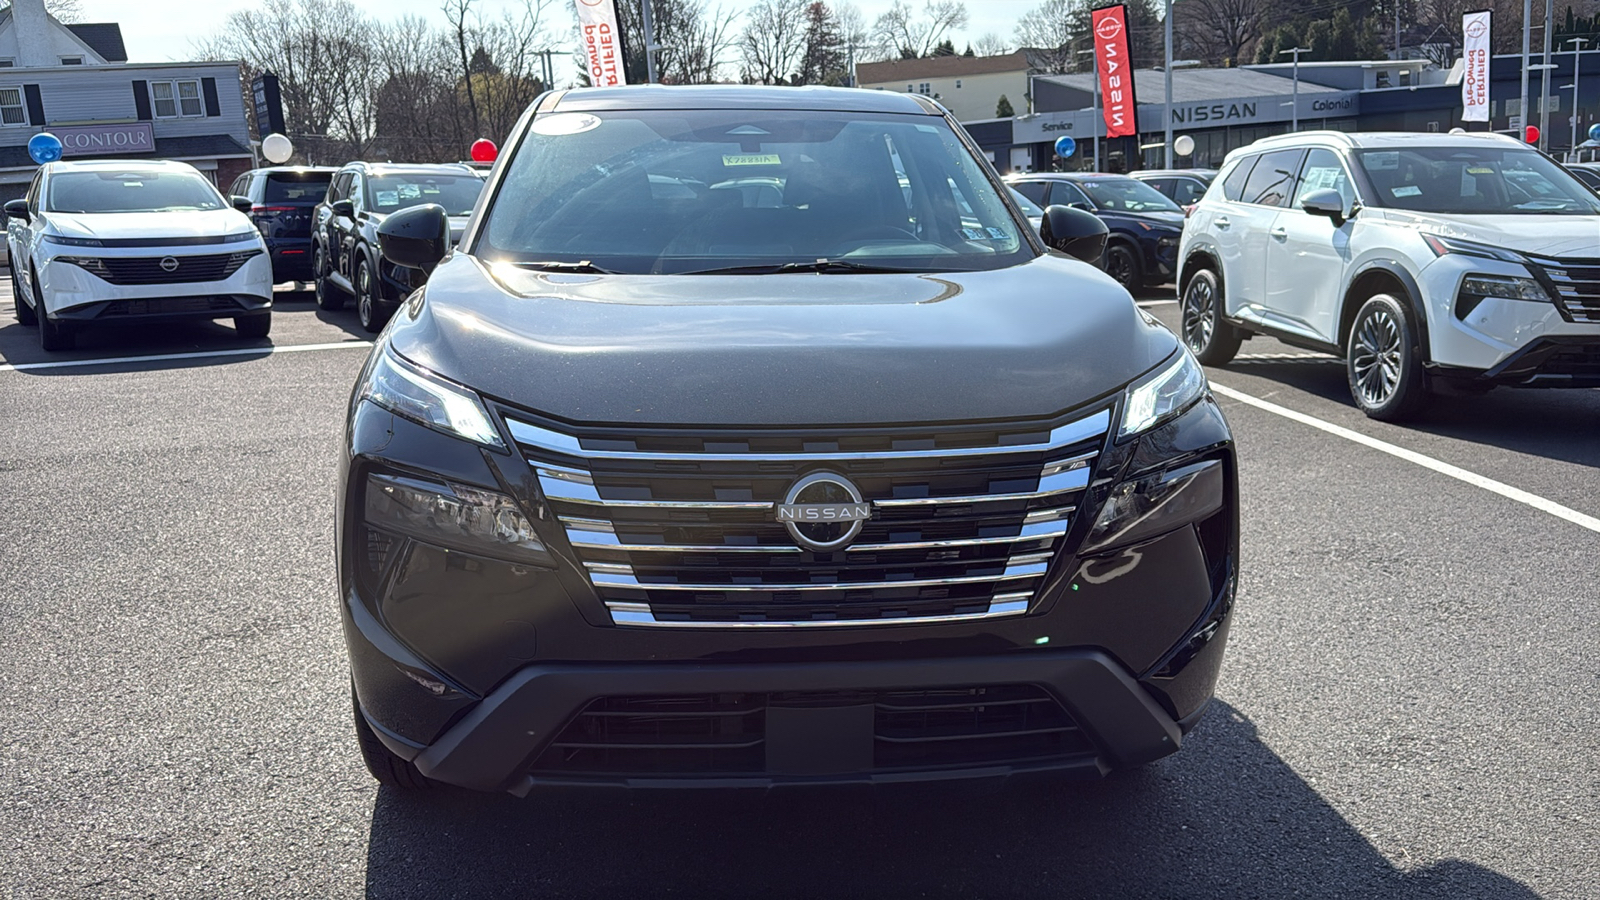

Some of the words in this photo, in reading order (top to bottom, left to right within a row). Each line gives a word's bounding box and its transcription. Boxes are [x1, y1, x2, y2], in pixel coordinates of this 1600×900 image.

[1312, 99, 1352, 112] Colonial
[1172, 102, 1256, 123] NISSAN
[1042, 121, 1073, 132] Service
[63, 132, 147, 148] CONTOUR
[780, 506, 868, 519] NISSAN
